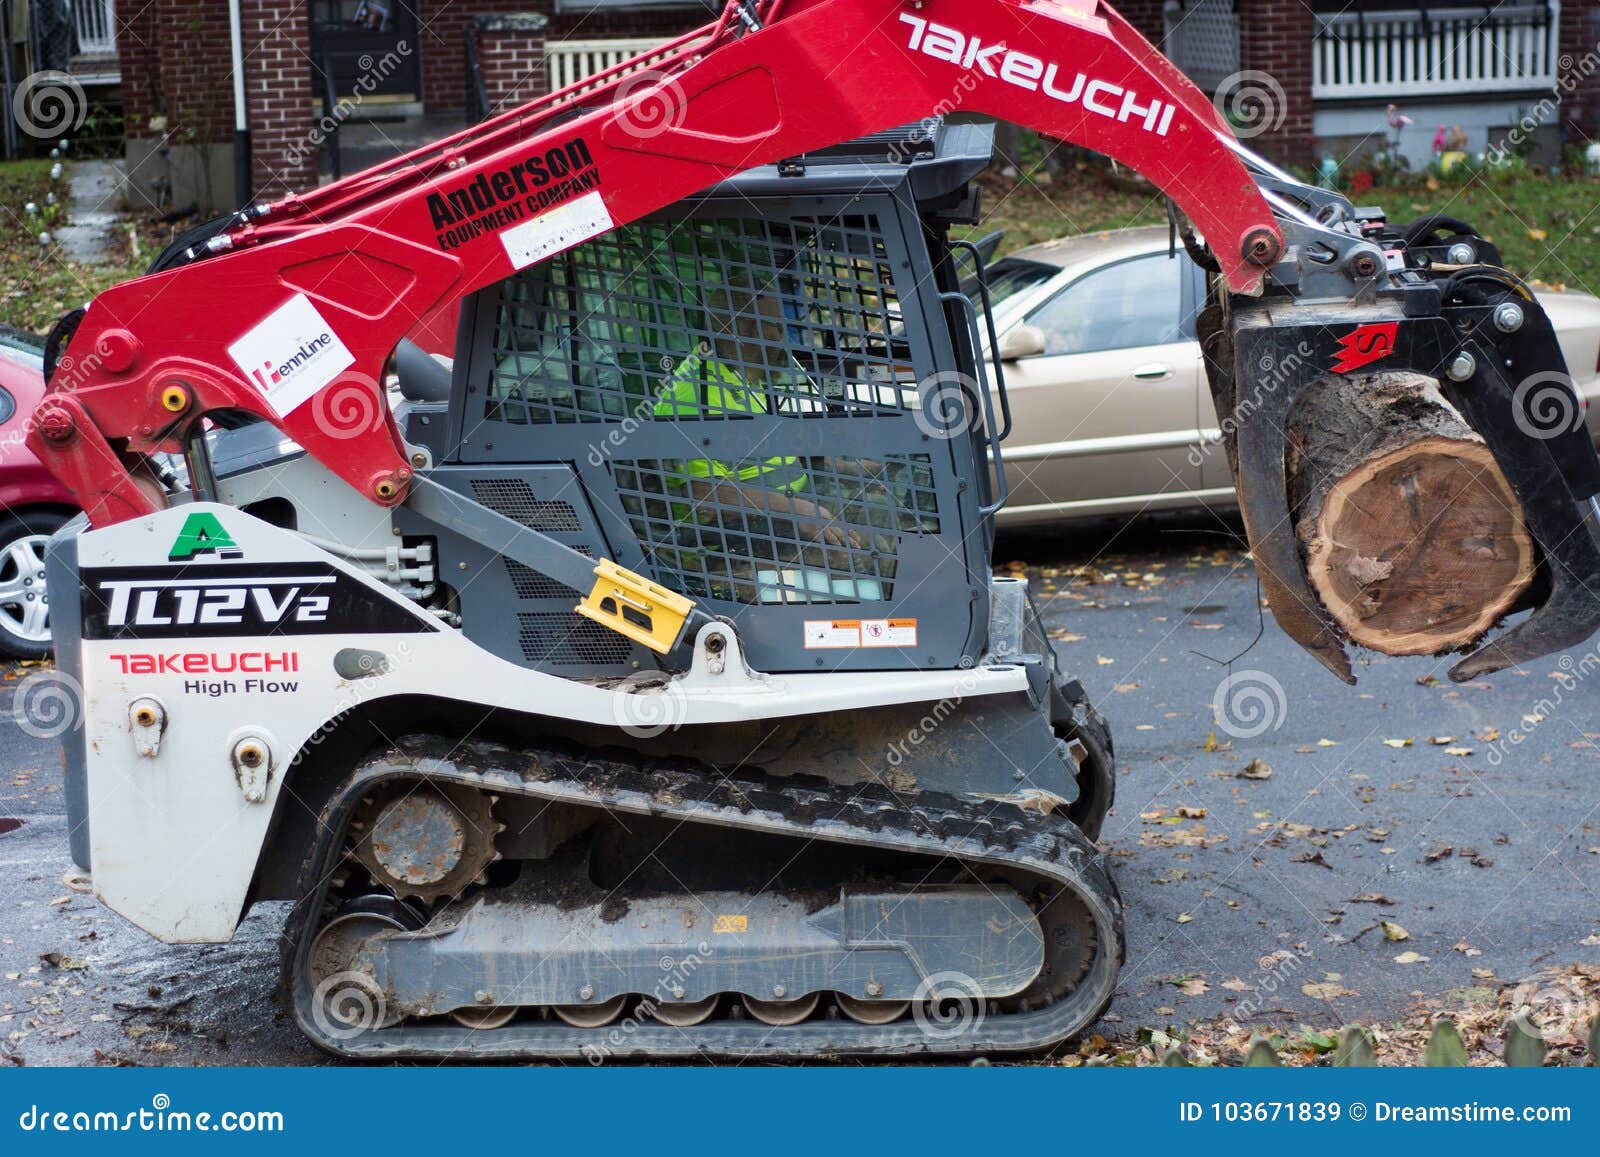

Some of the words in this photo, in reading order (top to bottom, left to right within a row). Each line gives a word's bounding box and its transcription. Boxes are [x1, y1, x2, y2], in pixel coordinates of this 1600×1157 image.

[427, 138, 593, 230] Anderson
[437, 201, 525, 250] EQUIPMENT
[526, 168, 602, 213] COMPANY
[184, 680, 237, 697] High
[245, 680, 298, 693] Flow
